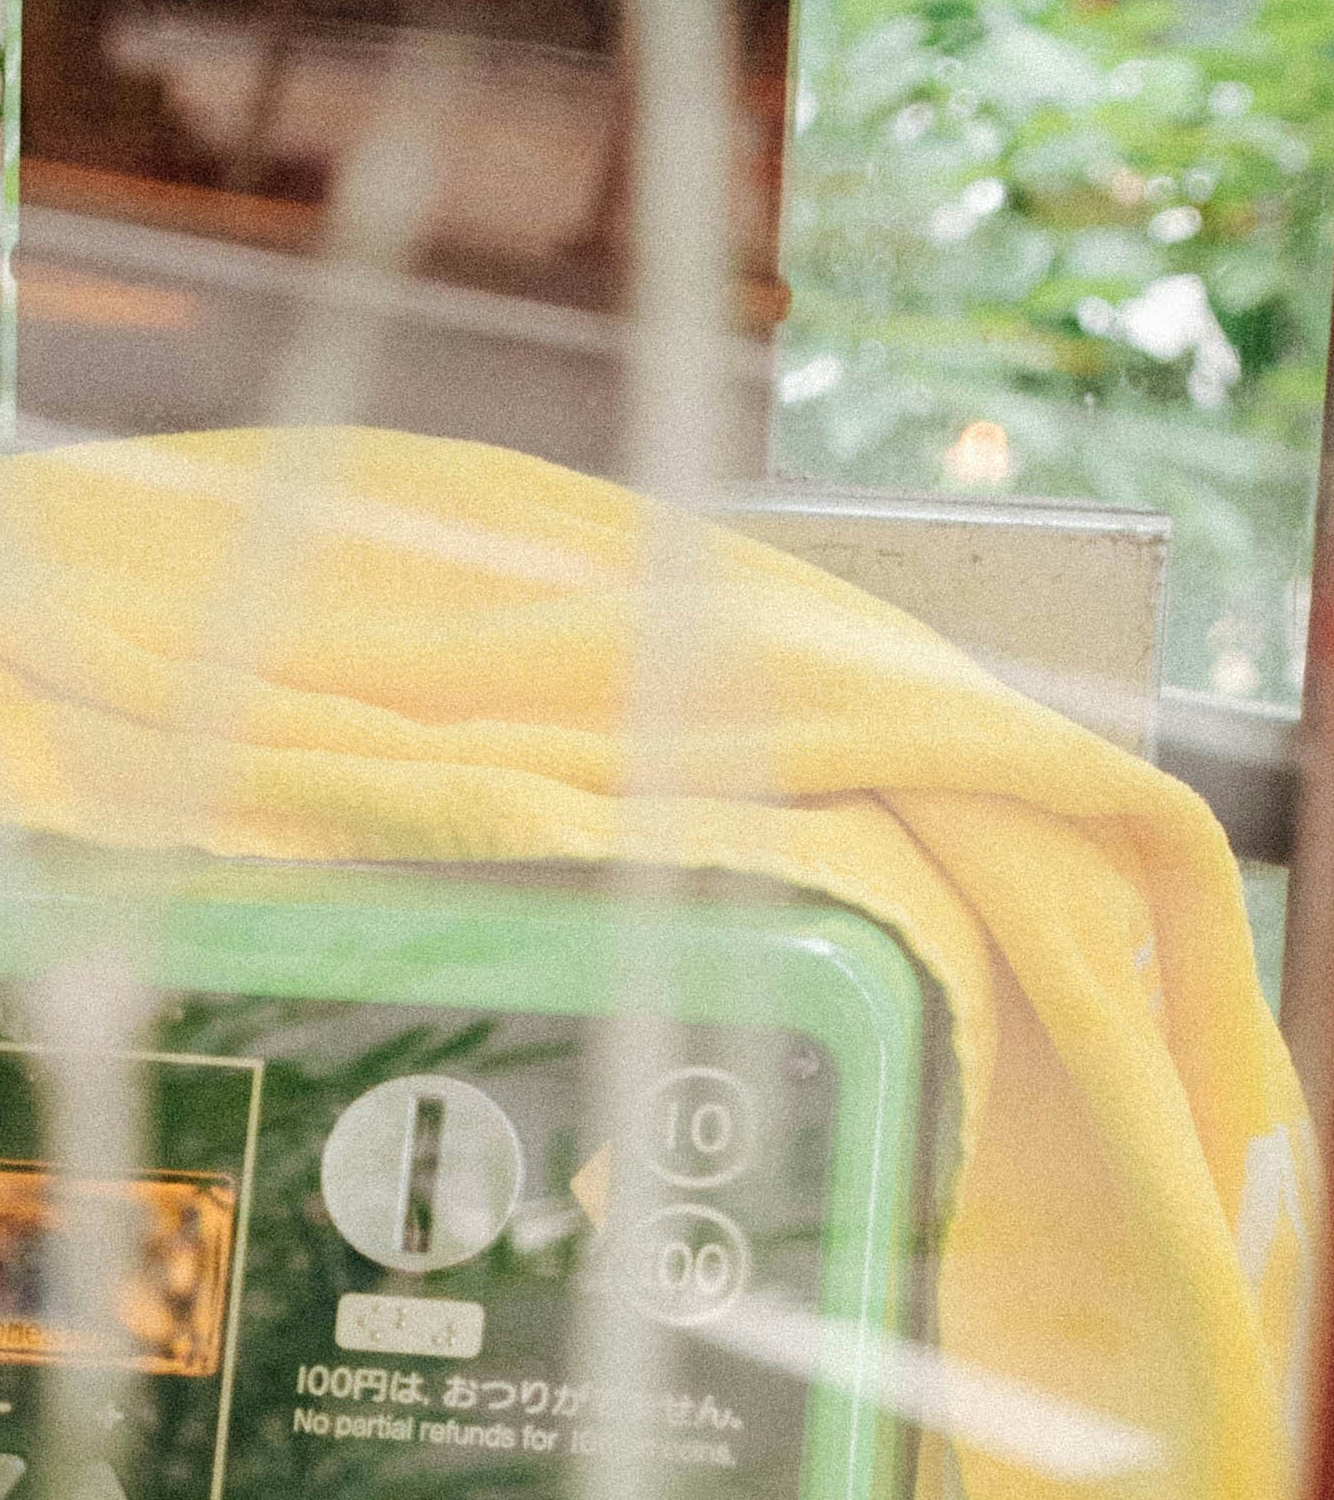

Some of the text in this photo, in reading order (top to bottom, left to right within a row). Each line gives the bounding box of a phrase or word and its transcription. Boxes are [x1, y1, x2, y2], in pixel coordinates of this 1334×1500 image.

[666, 1101, 733, 1155] 10
[643, 1239, 730, 1295] 00
[292, 1408, 330, 1436] No
[335, 1411, 413, 1443] partial
[419, 1416, 517, 1450] refunds
[521, 1422, 559, 1452] for
